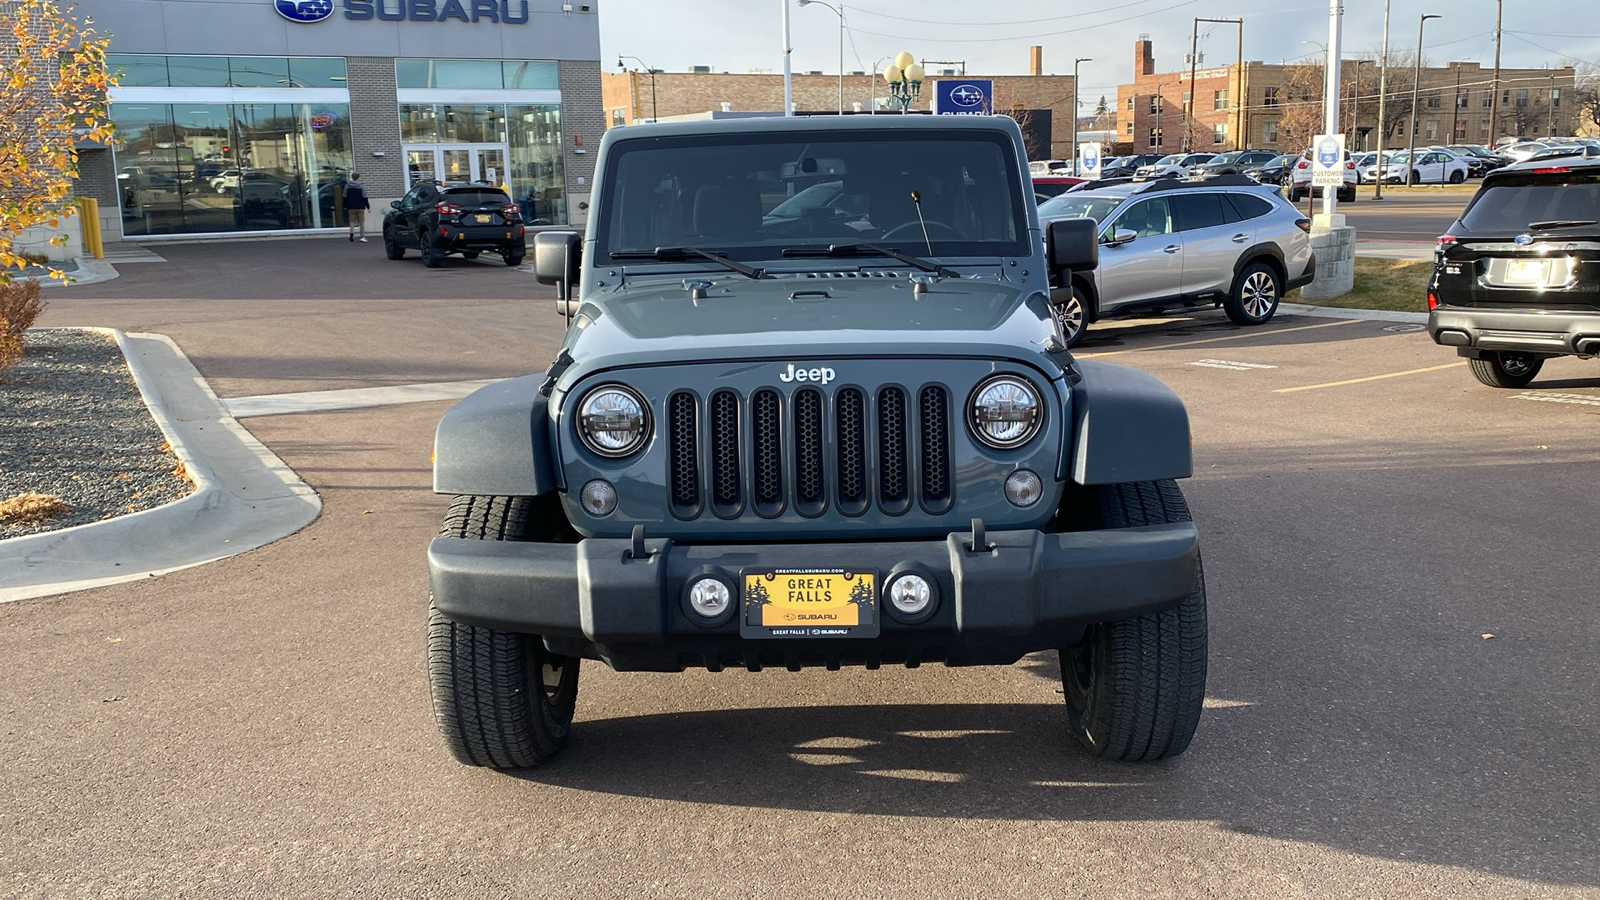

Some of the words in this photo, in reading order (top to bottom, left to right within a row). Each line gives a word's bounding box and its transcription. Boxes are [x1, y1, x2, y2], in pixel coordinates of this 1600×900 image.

[344, 0, 529, 24] SUBARU
[779, 363, 836, 385] Jeep
[788, 578, 832, 589] GREAT
[788, 590, 832, 602] FALLS
